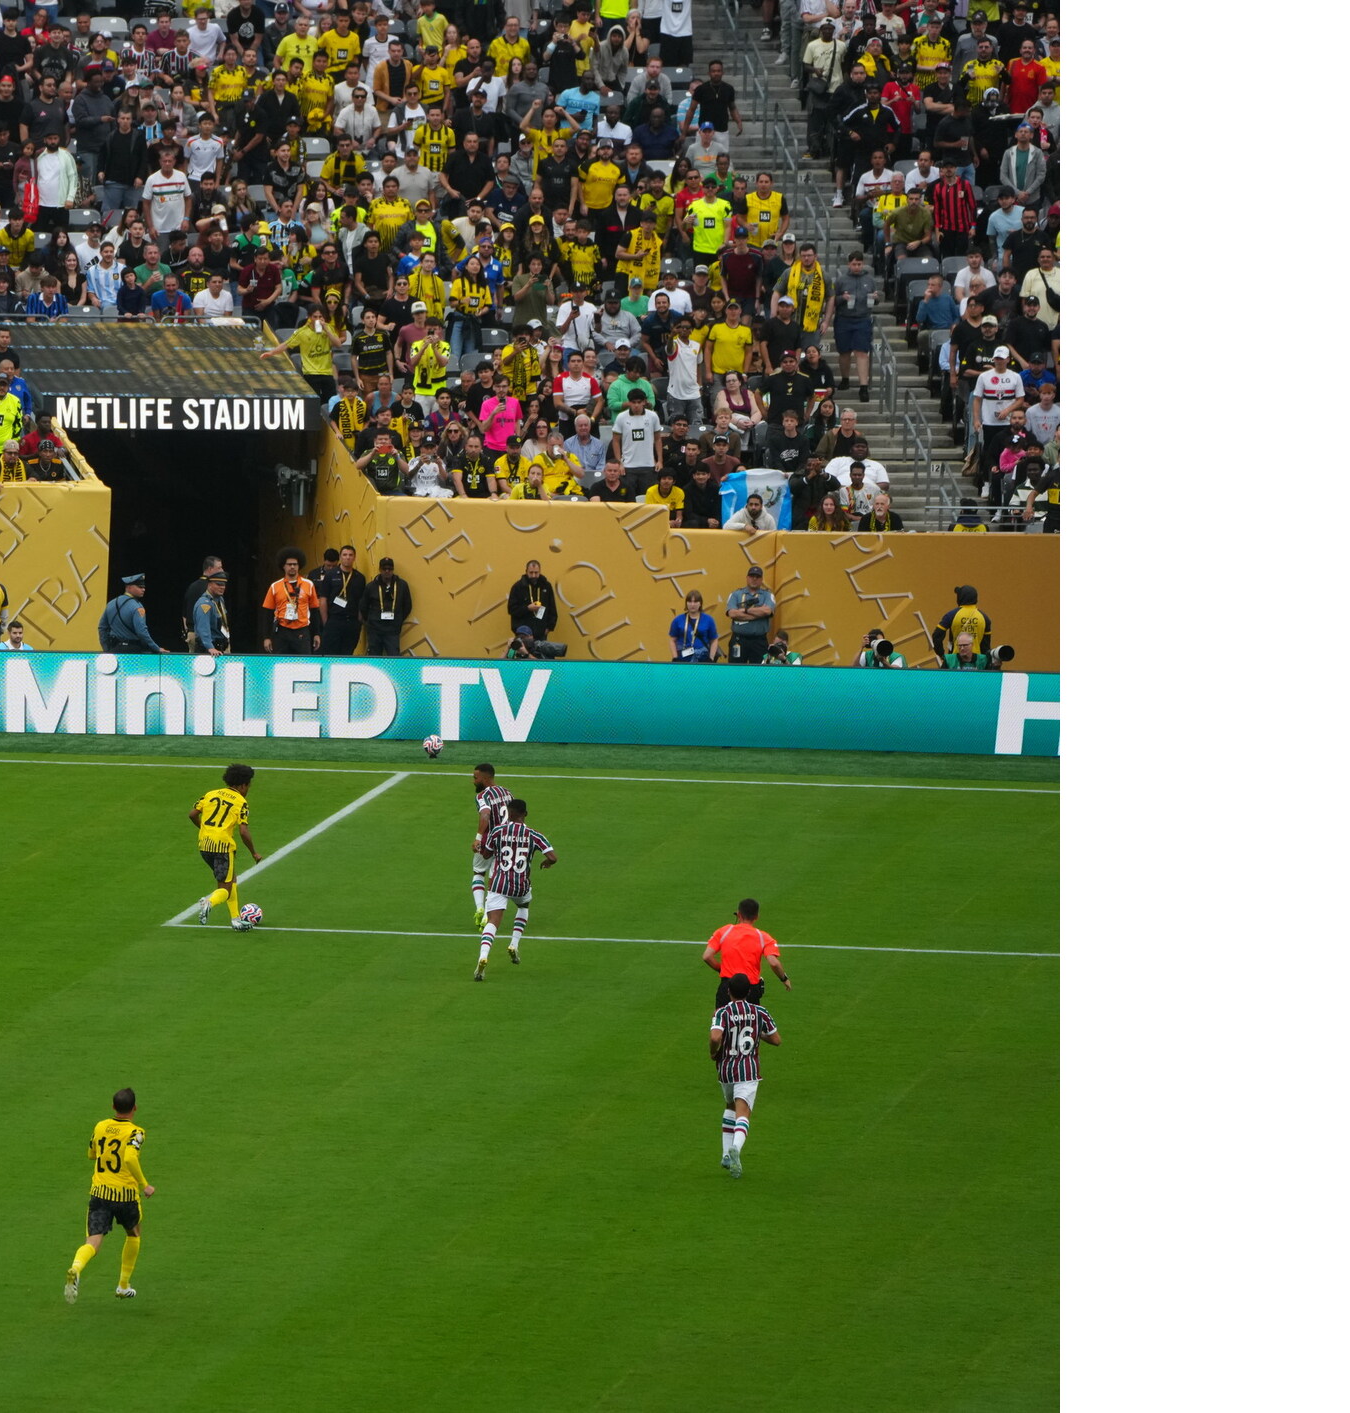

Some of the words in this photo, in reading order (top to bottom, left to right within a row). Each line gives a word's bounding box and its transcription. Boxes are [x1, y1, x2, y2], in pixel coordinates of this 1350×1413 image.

[704, 218, 715, 227] 1&1
[760, 212, 770, 220] 1&1
[56, 397, 173, 430] METLIFE
[182, 398, 306, 431] STADIUM
[632, 430, 645, 440] 1&1
[377, 469, 388, 477] 1&1
[421, 666, 553, 742] TV
[204, 797, 234, 827] 27
[499, 846, 529, 874] 35
[729, 1026, 755, 1055] 16
[97, 1136, 122, 1174] 13
